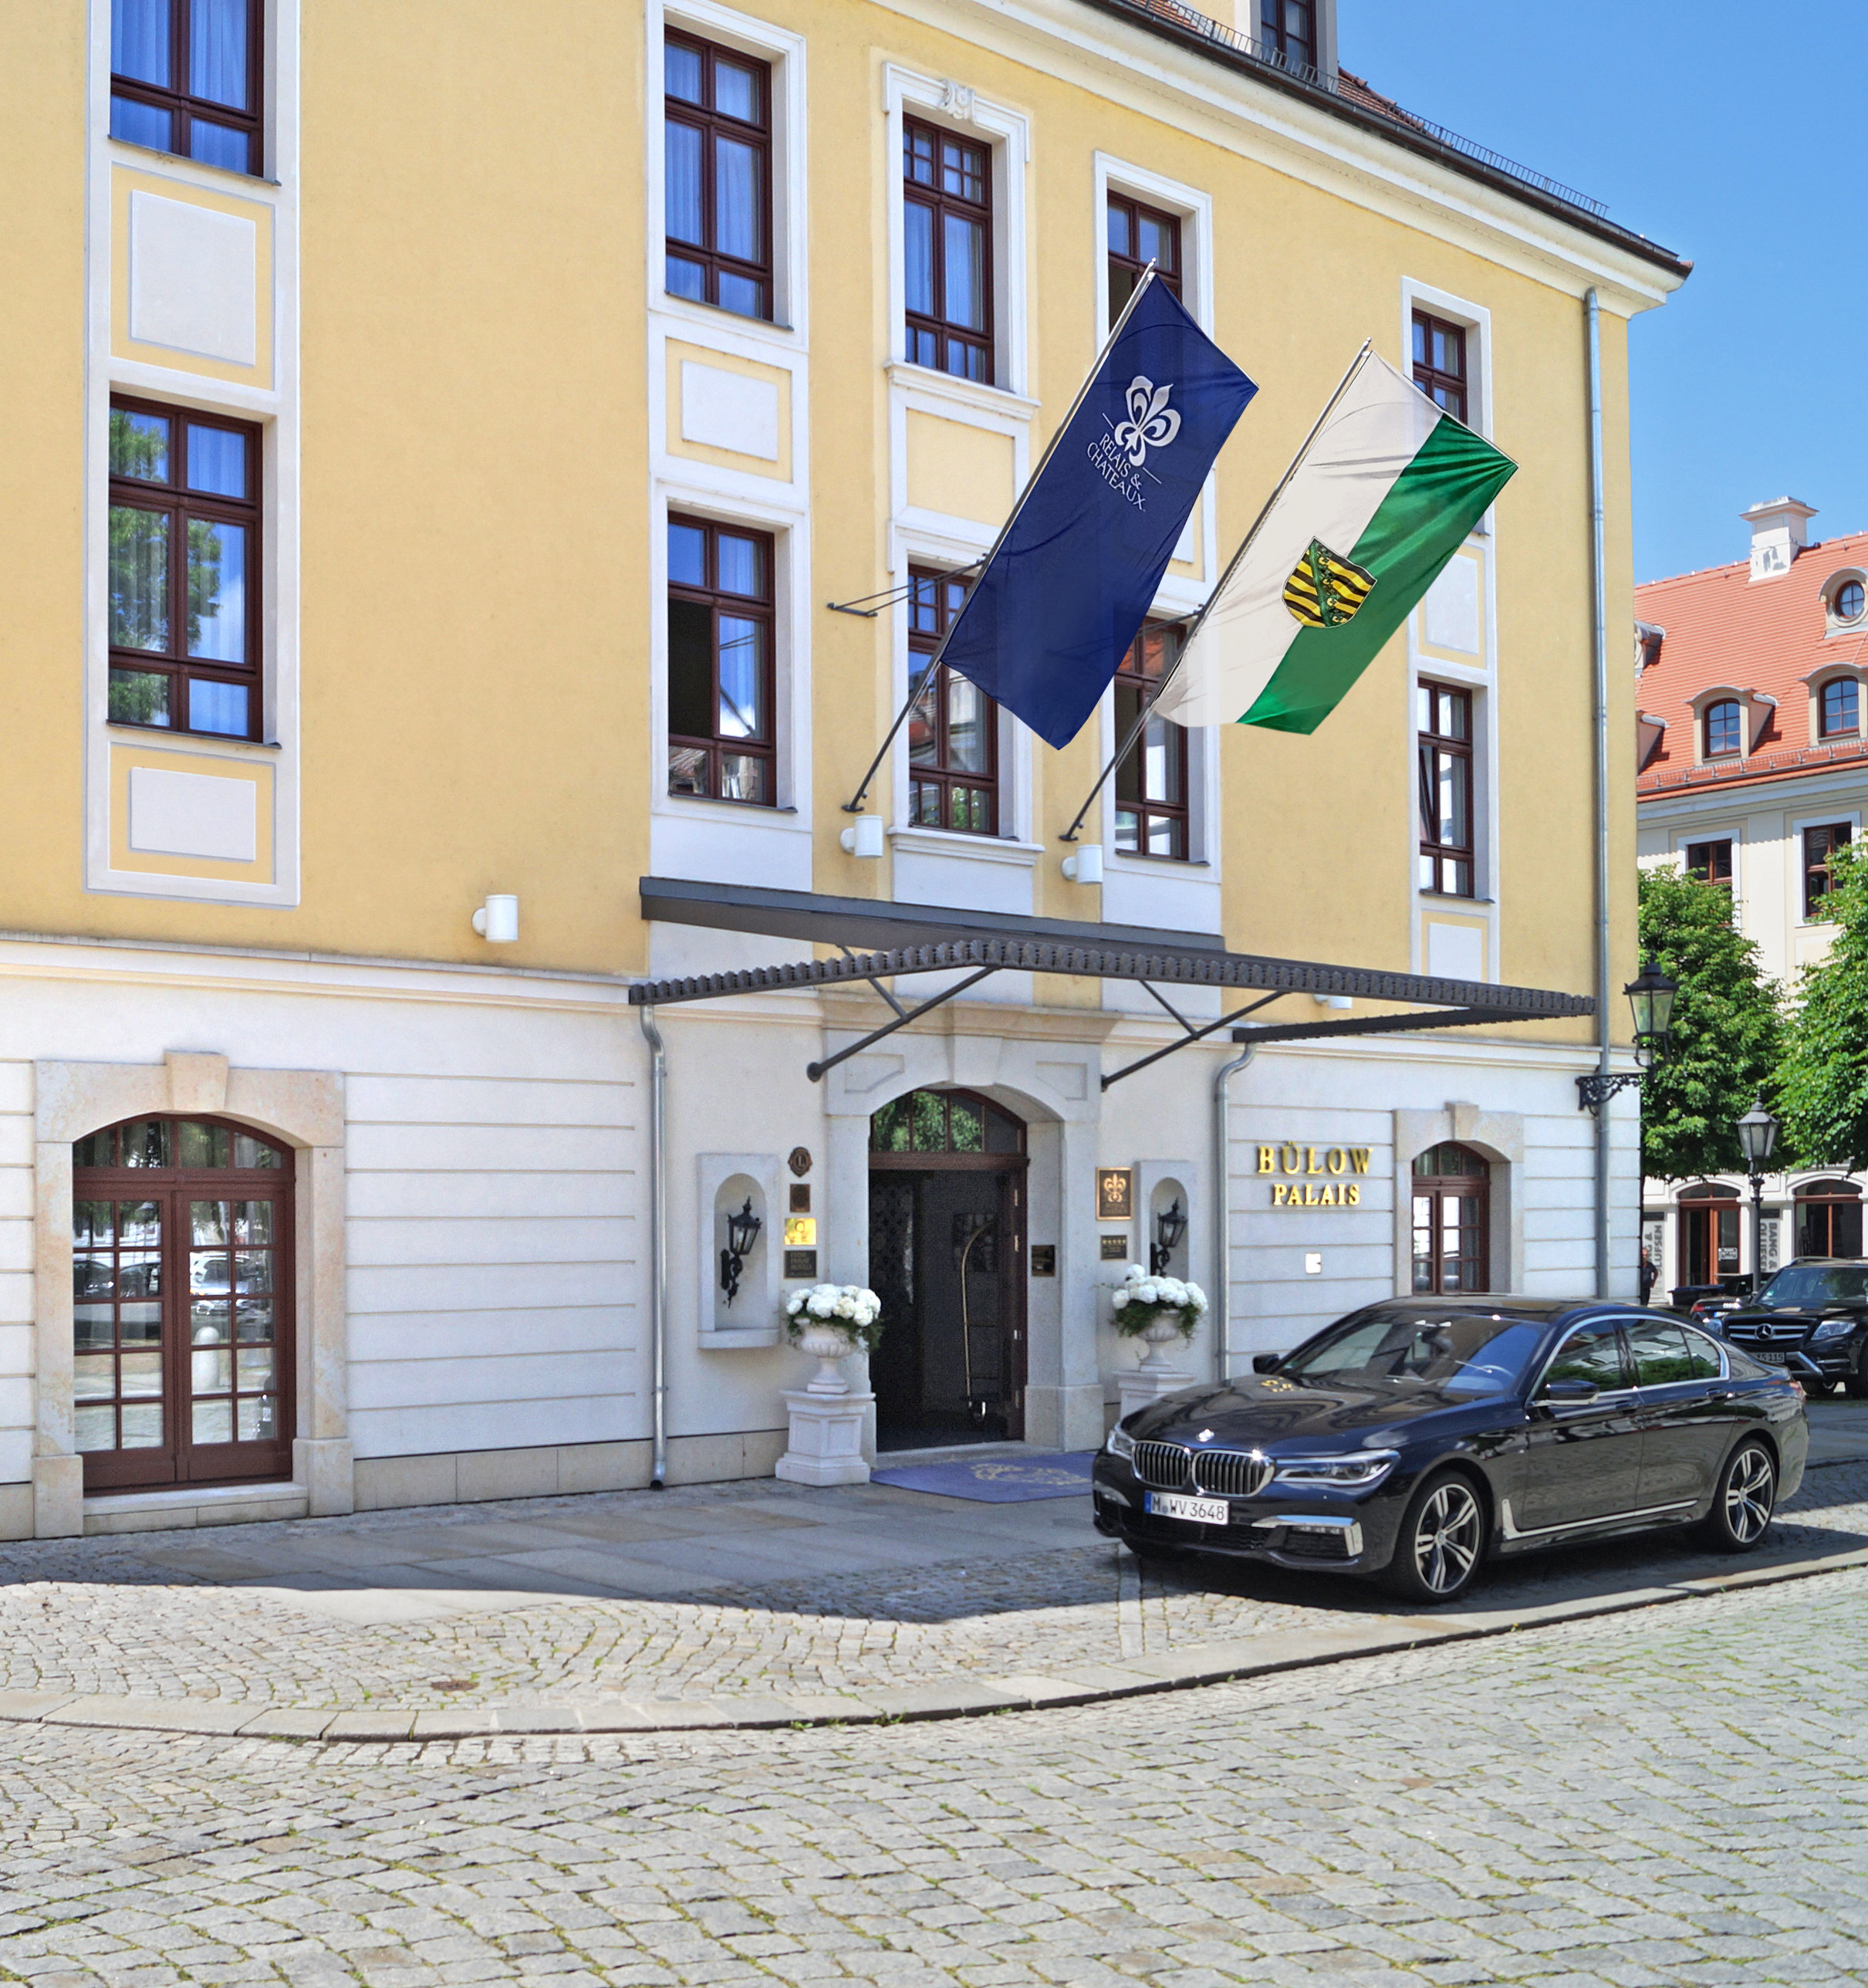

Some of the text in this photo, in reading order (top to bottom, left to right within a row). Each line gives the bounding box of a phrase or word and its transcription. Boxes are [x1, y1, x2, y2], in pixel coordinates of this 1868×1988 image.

[1100, 433, 1142, 490] RELAIS &
[1258, 1141, 1373, 1175] BÜLOW
[1273, 1183, 1360, 1205] PALAIS
[1768, 1222, 1778, 1270] BANG &
[1152, 1496, 1160, 1512] M
[1190, 1502, 1225, 1521] 3648
